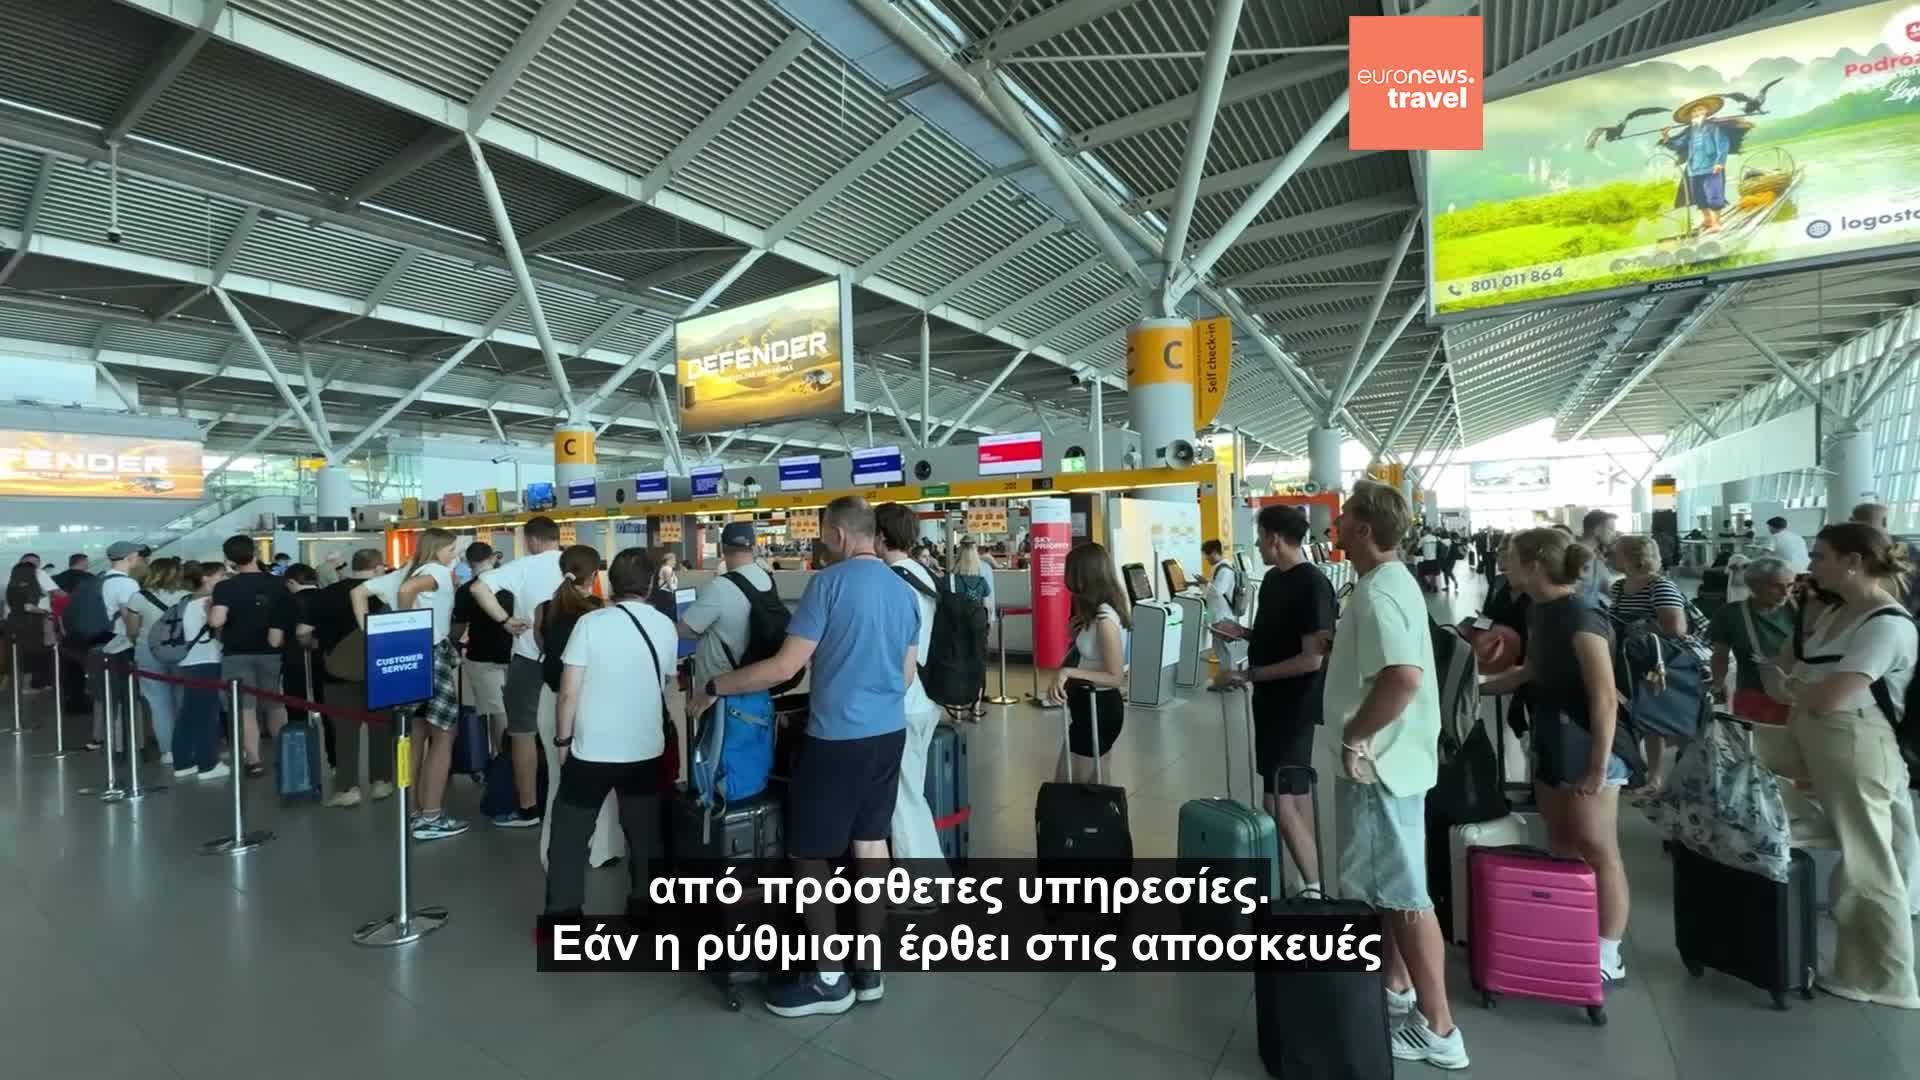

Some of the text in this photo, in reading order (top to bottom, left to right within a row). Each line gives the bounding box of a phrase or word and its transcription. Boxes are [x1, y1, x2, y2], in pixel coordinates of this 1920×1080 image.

[1471, 266, 1565, 293] 801 011 864
[686, 330, 829, 381] DEFENDER
[1163, 339, 1184, 370] C
[1206, 322, 1218, 393] Self check-in
[563, 438, 577, 456] C
[376, 653, 424, 667] CUSTOMER
[381, 662, 419, 675] SERVICE
